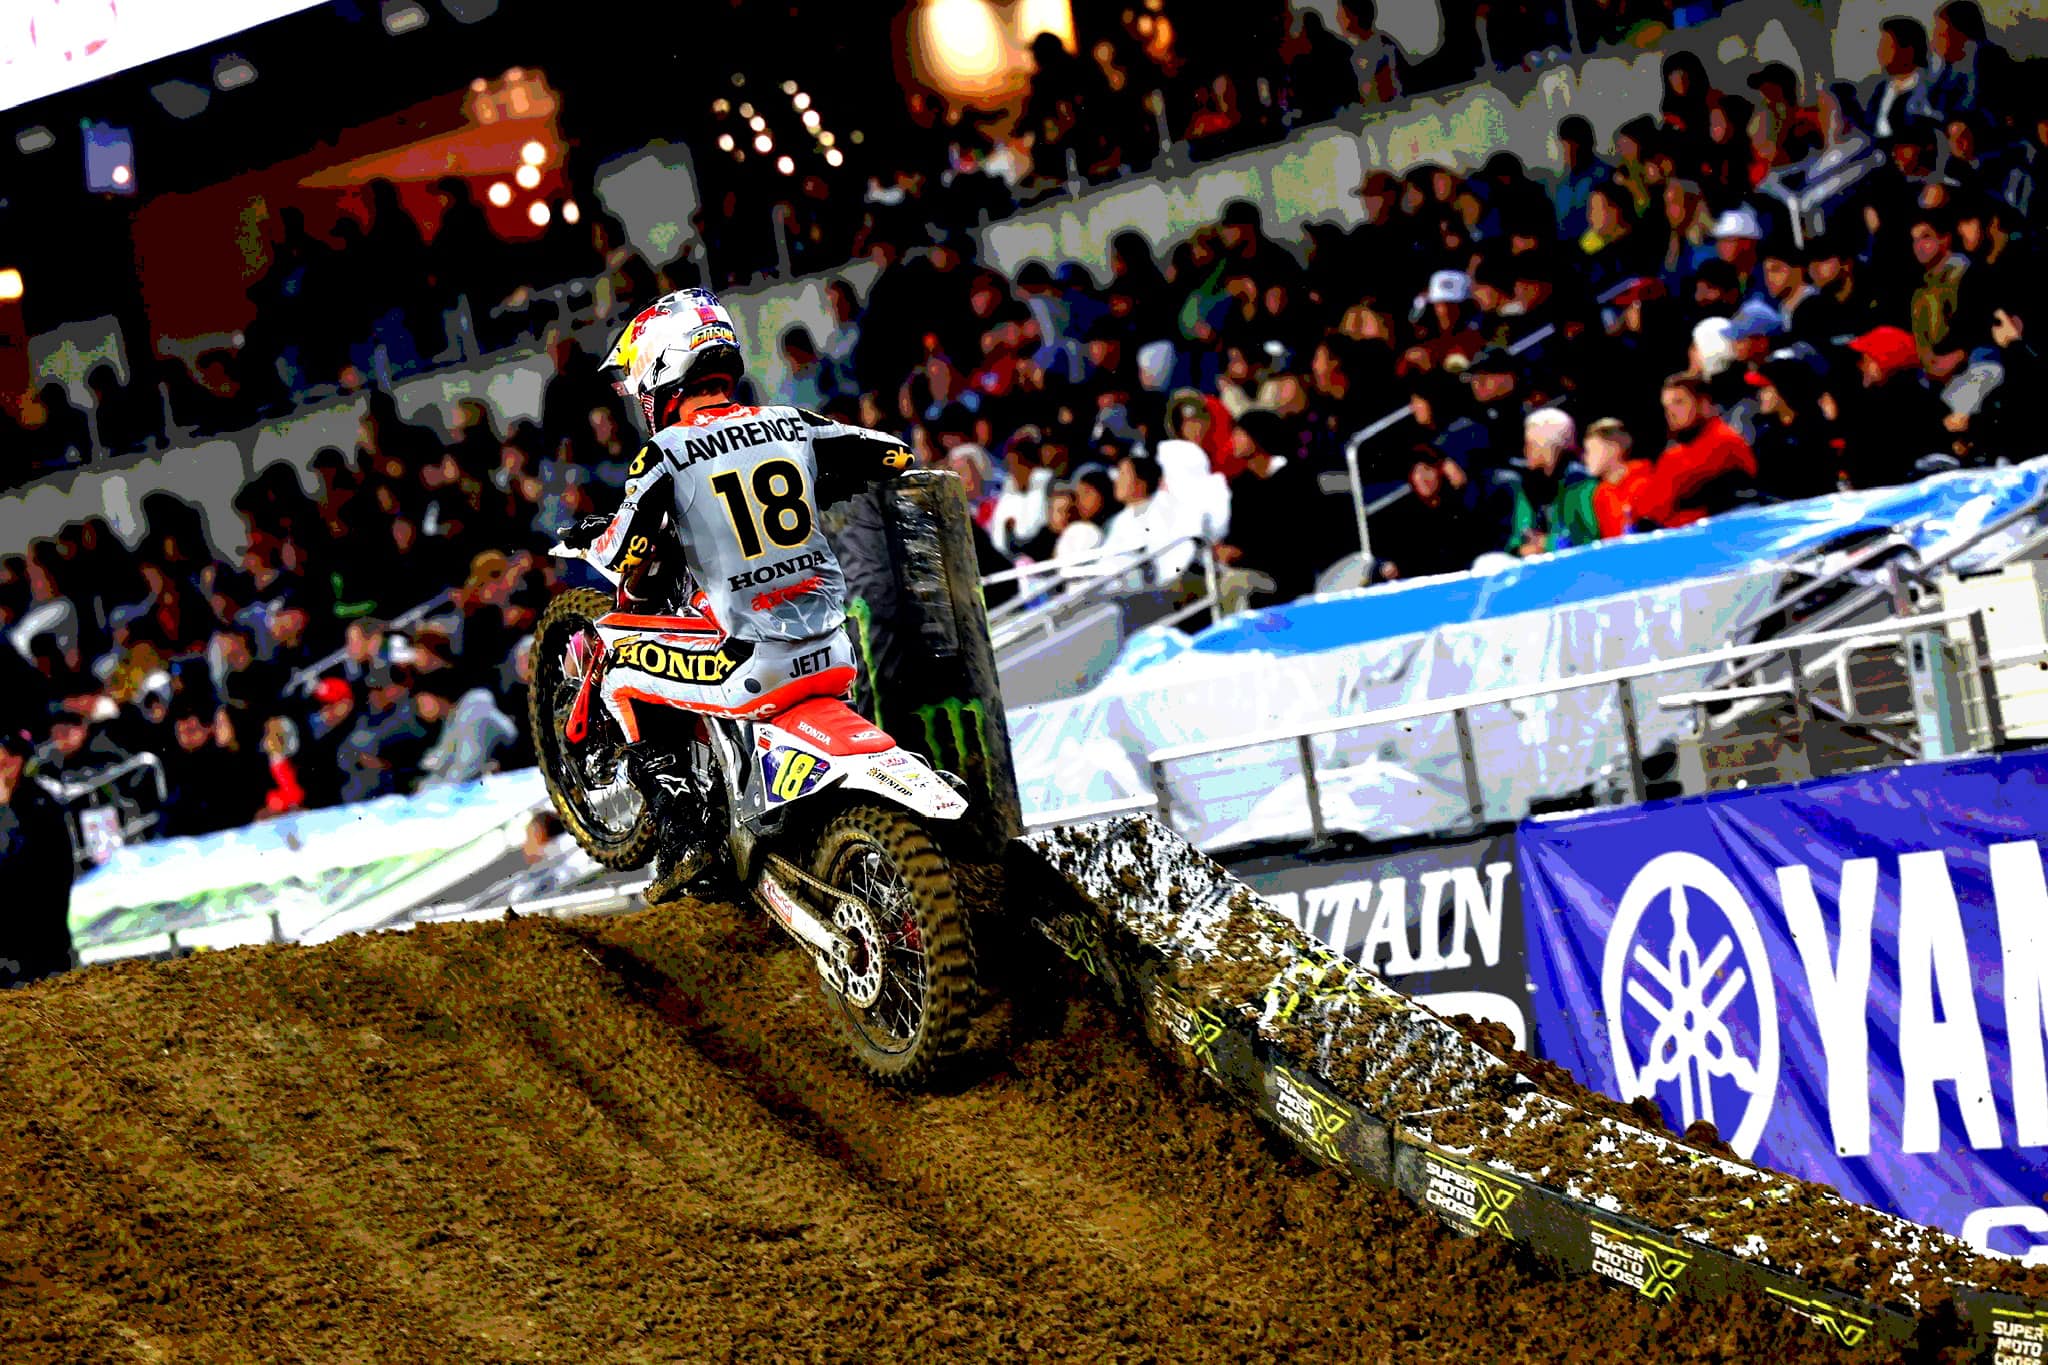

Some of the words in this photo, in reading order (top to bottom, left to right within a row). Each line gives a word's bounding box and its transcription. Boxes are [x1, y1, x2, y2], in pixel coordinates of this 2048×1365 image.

[664, 416, 808, 472] LAWRENCE
[709, 457, 813, 560] 18
[727, 550, 828, 592] HONDA
[614, 642, 737, 682] HONDA
[789, 646, 832, 678] JETT
[797, 720, 831, 746] HONDA
[771, 749, 816, 801] 18
[875, 772, 913, 797] DUNLOP
[1425, 1161, 1477, 1192] SUPER
[1429, 1177, 1475, 1206] MOTO
[1425, 1188, 1477, 1220] CROSS
[1590, 1231, 1645, 1263] SUPER
[1595, 1246, 1643, 1275] MOTO
[1592, 1260, 1645, 1289] CROSS
[1993, 1320, 2044, 1342] SUPER
[1997, 1336, 2042, 1358] MOTO
